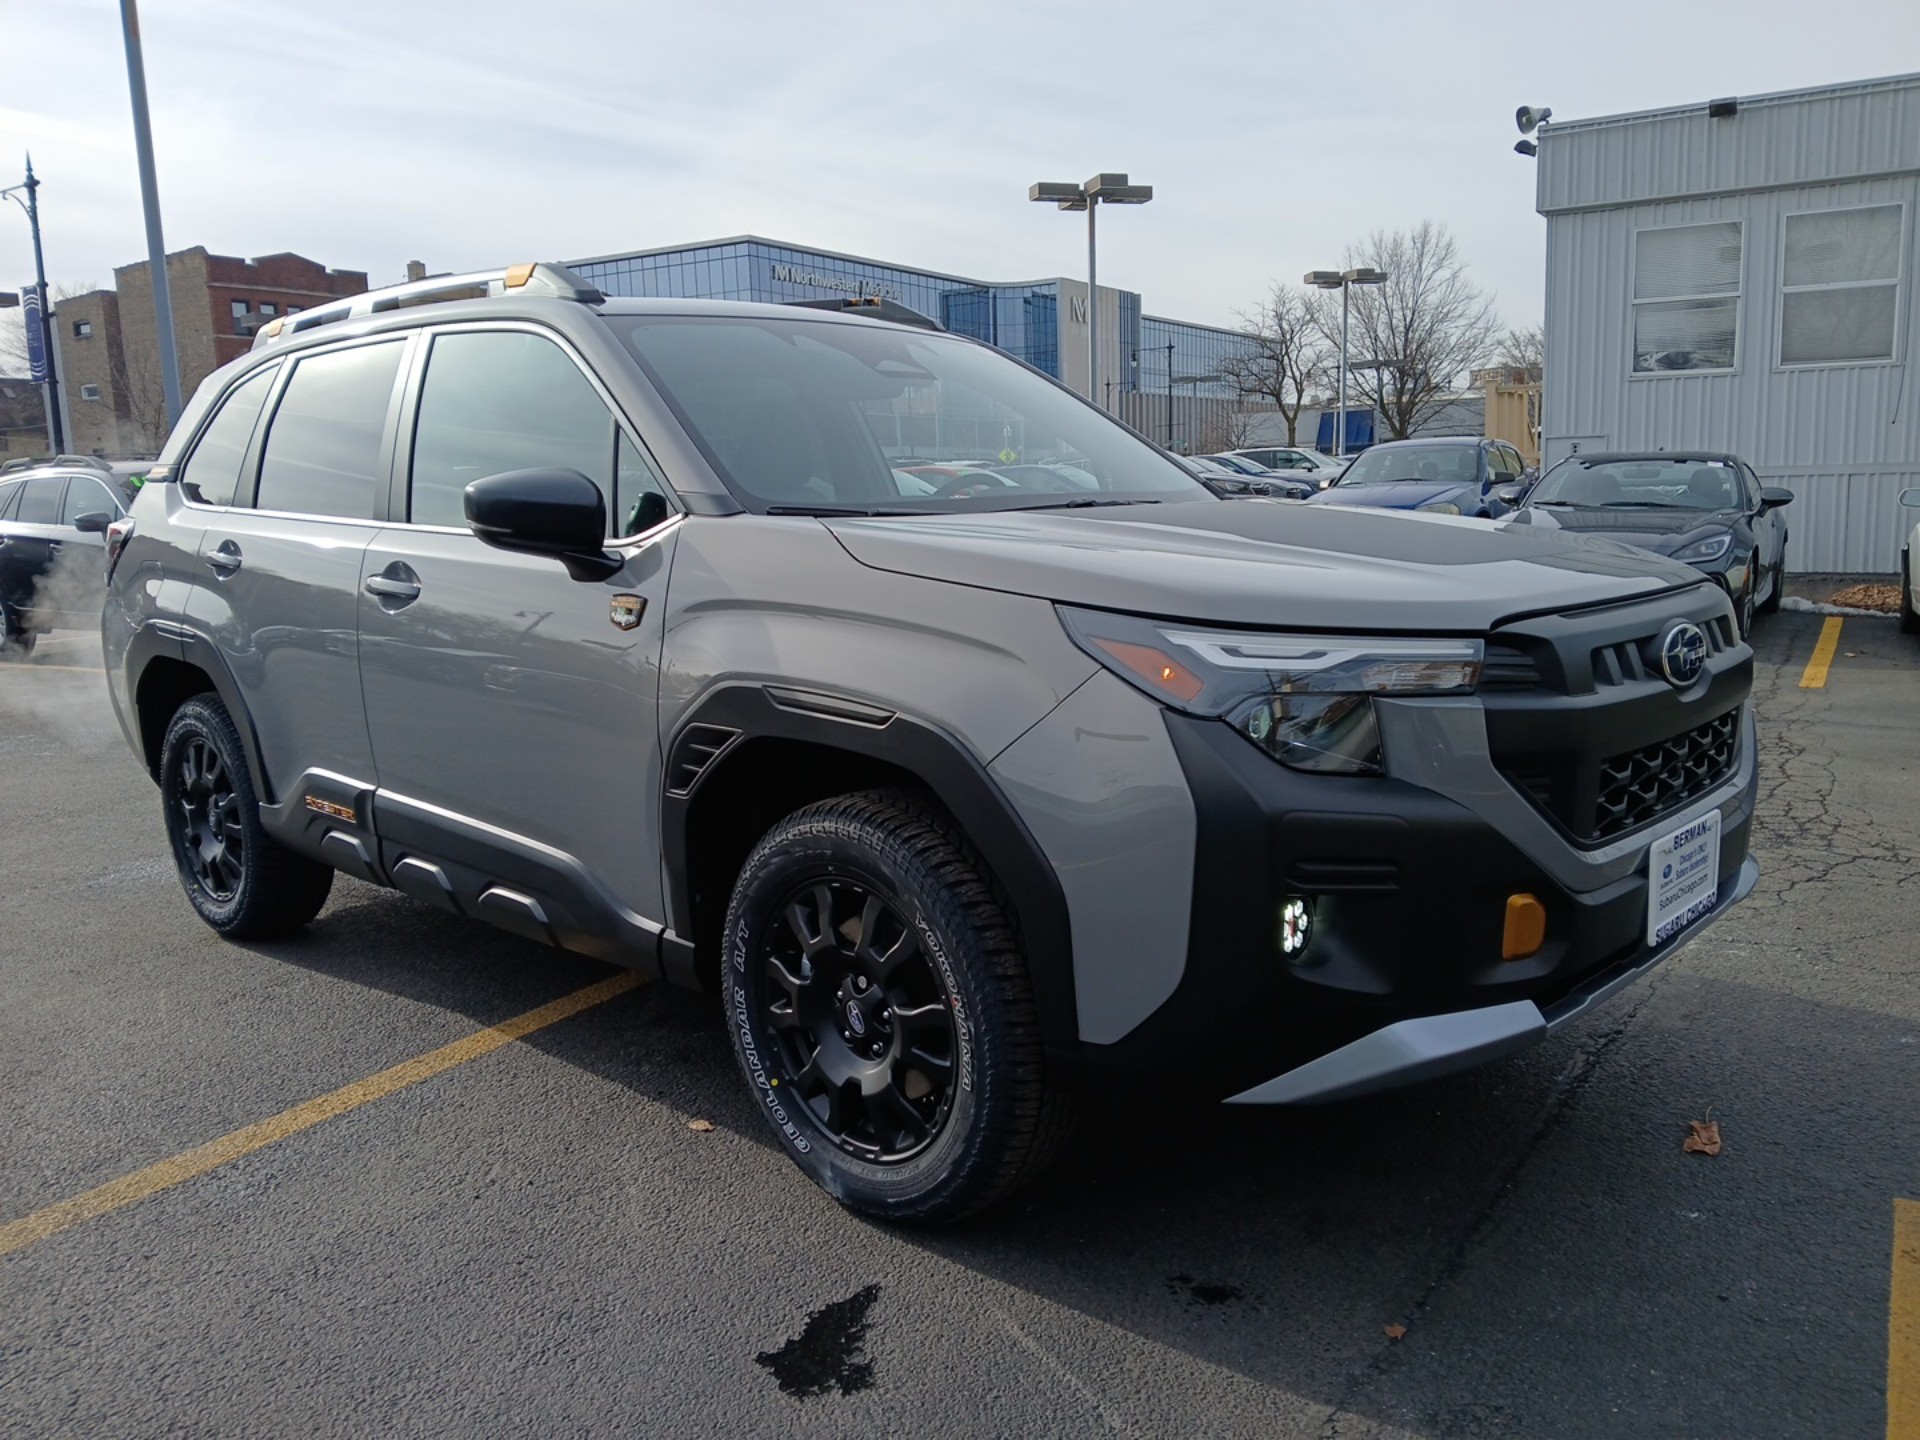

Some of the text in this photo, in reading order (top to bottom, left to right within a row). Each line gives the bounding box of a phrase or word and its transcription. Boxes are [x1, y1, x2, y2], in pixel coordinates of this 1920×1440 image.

[790, 266, 861, 294] Northwestern
[1673, 820, 1707, 850] BERMAN
[1659, 873, 1708, 912] SubaruChicago.com
[1656, 911, 1685, 945] SUBARU
[915, 911, 972, 1092] YOKOHAMA
[734, 918, 811, 1153] GEOLANDAR A/T
